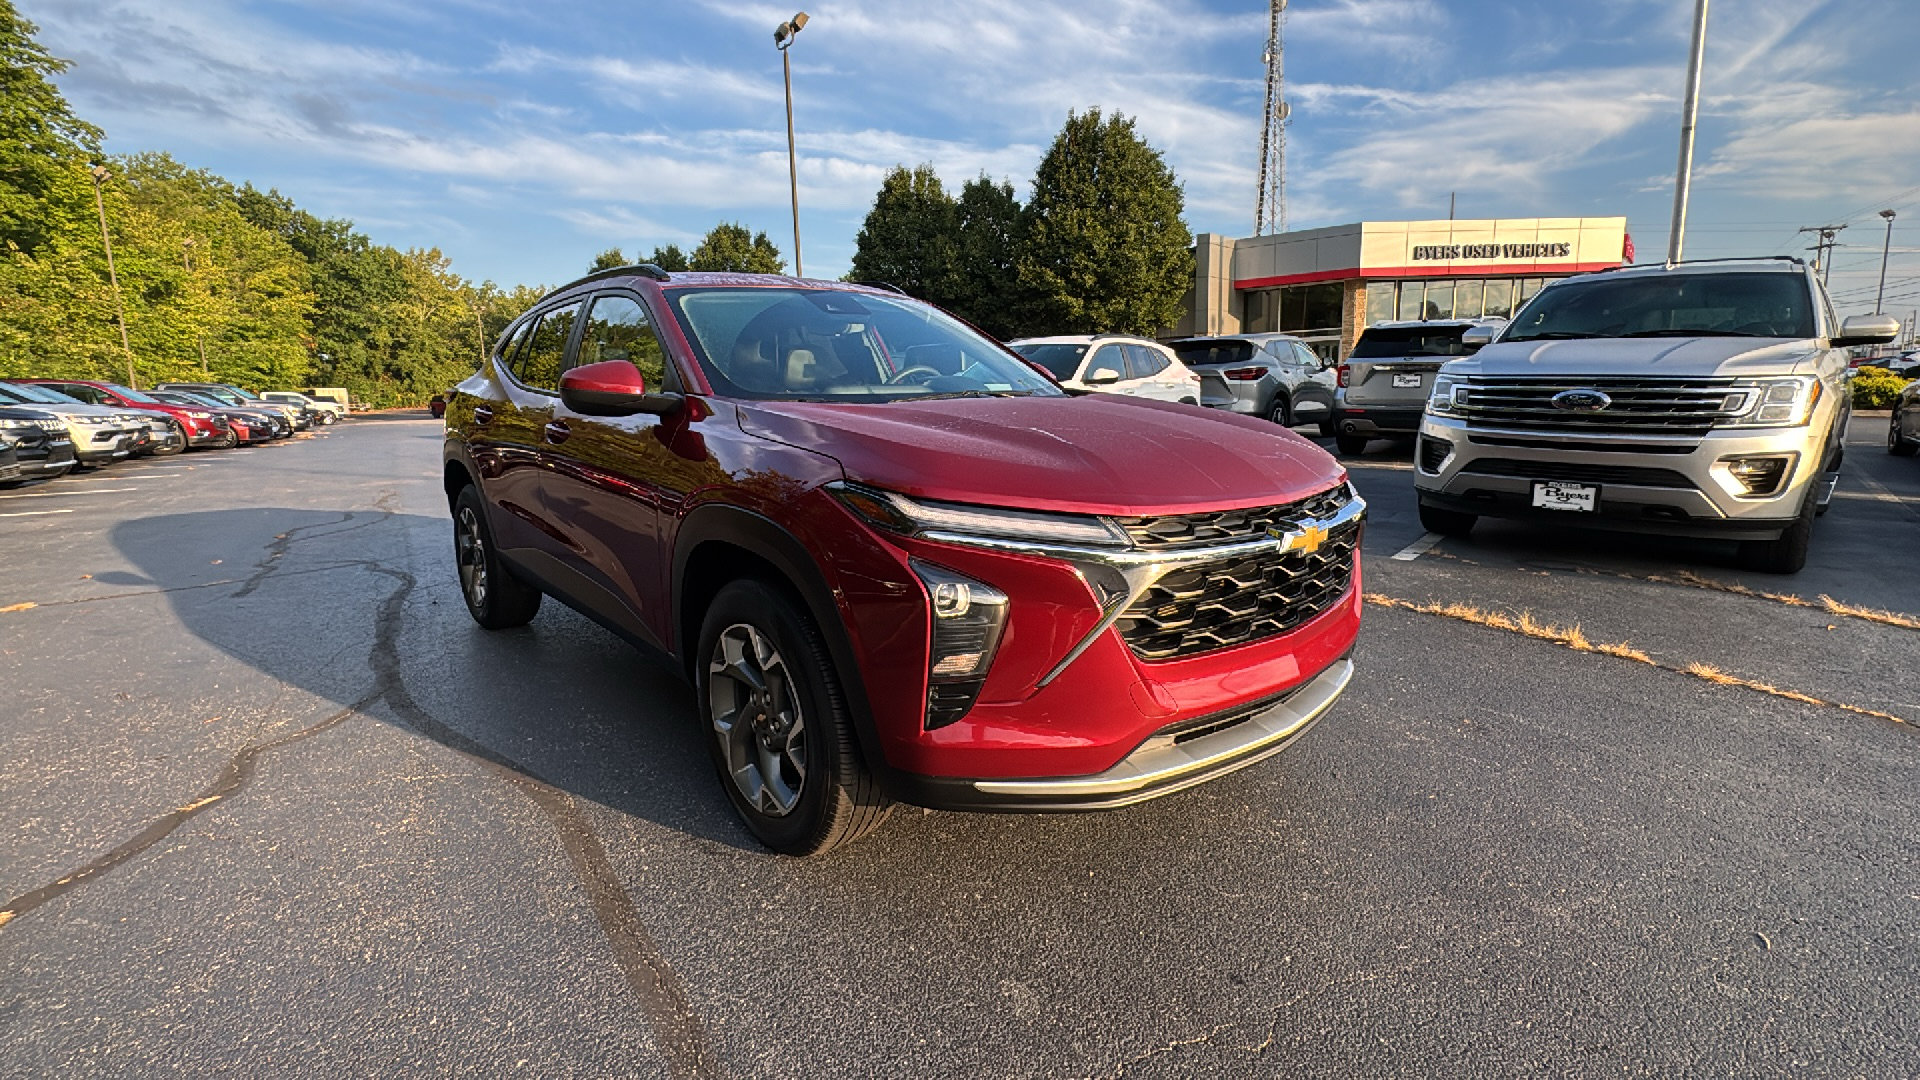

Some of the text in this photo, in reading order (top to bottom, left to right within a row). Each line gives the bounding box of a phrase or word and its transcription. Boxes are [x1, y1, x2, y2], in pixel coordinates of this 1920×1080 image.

[1412, 242, 1571, 260] BYERS USED VEHICLES
